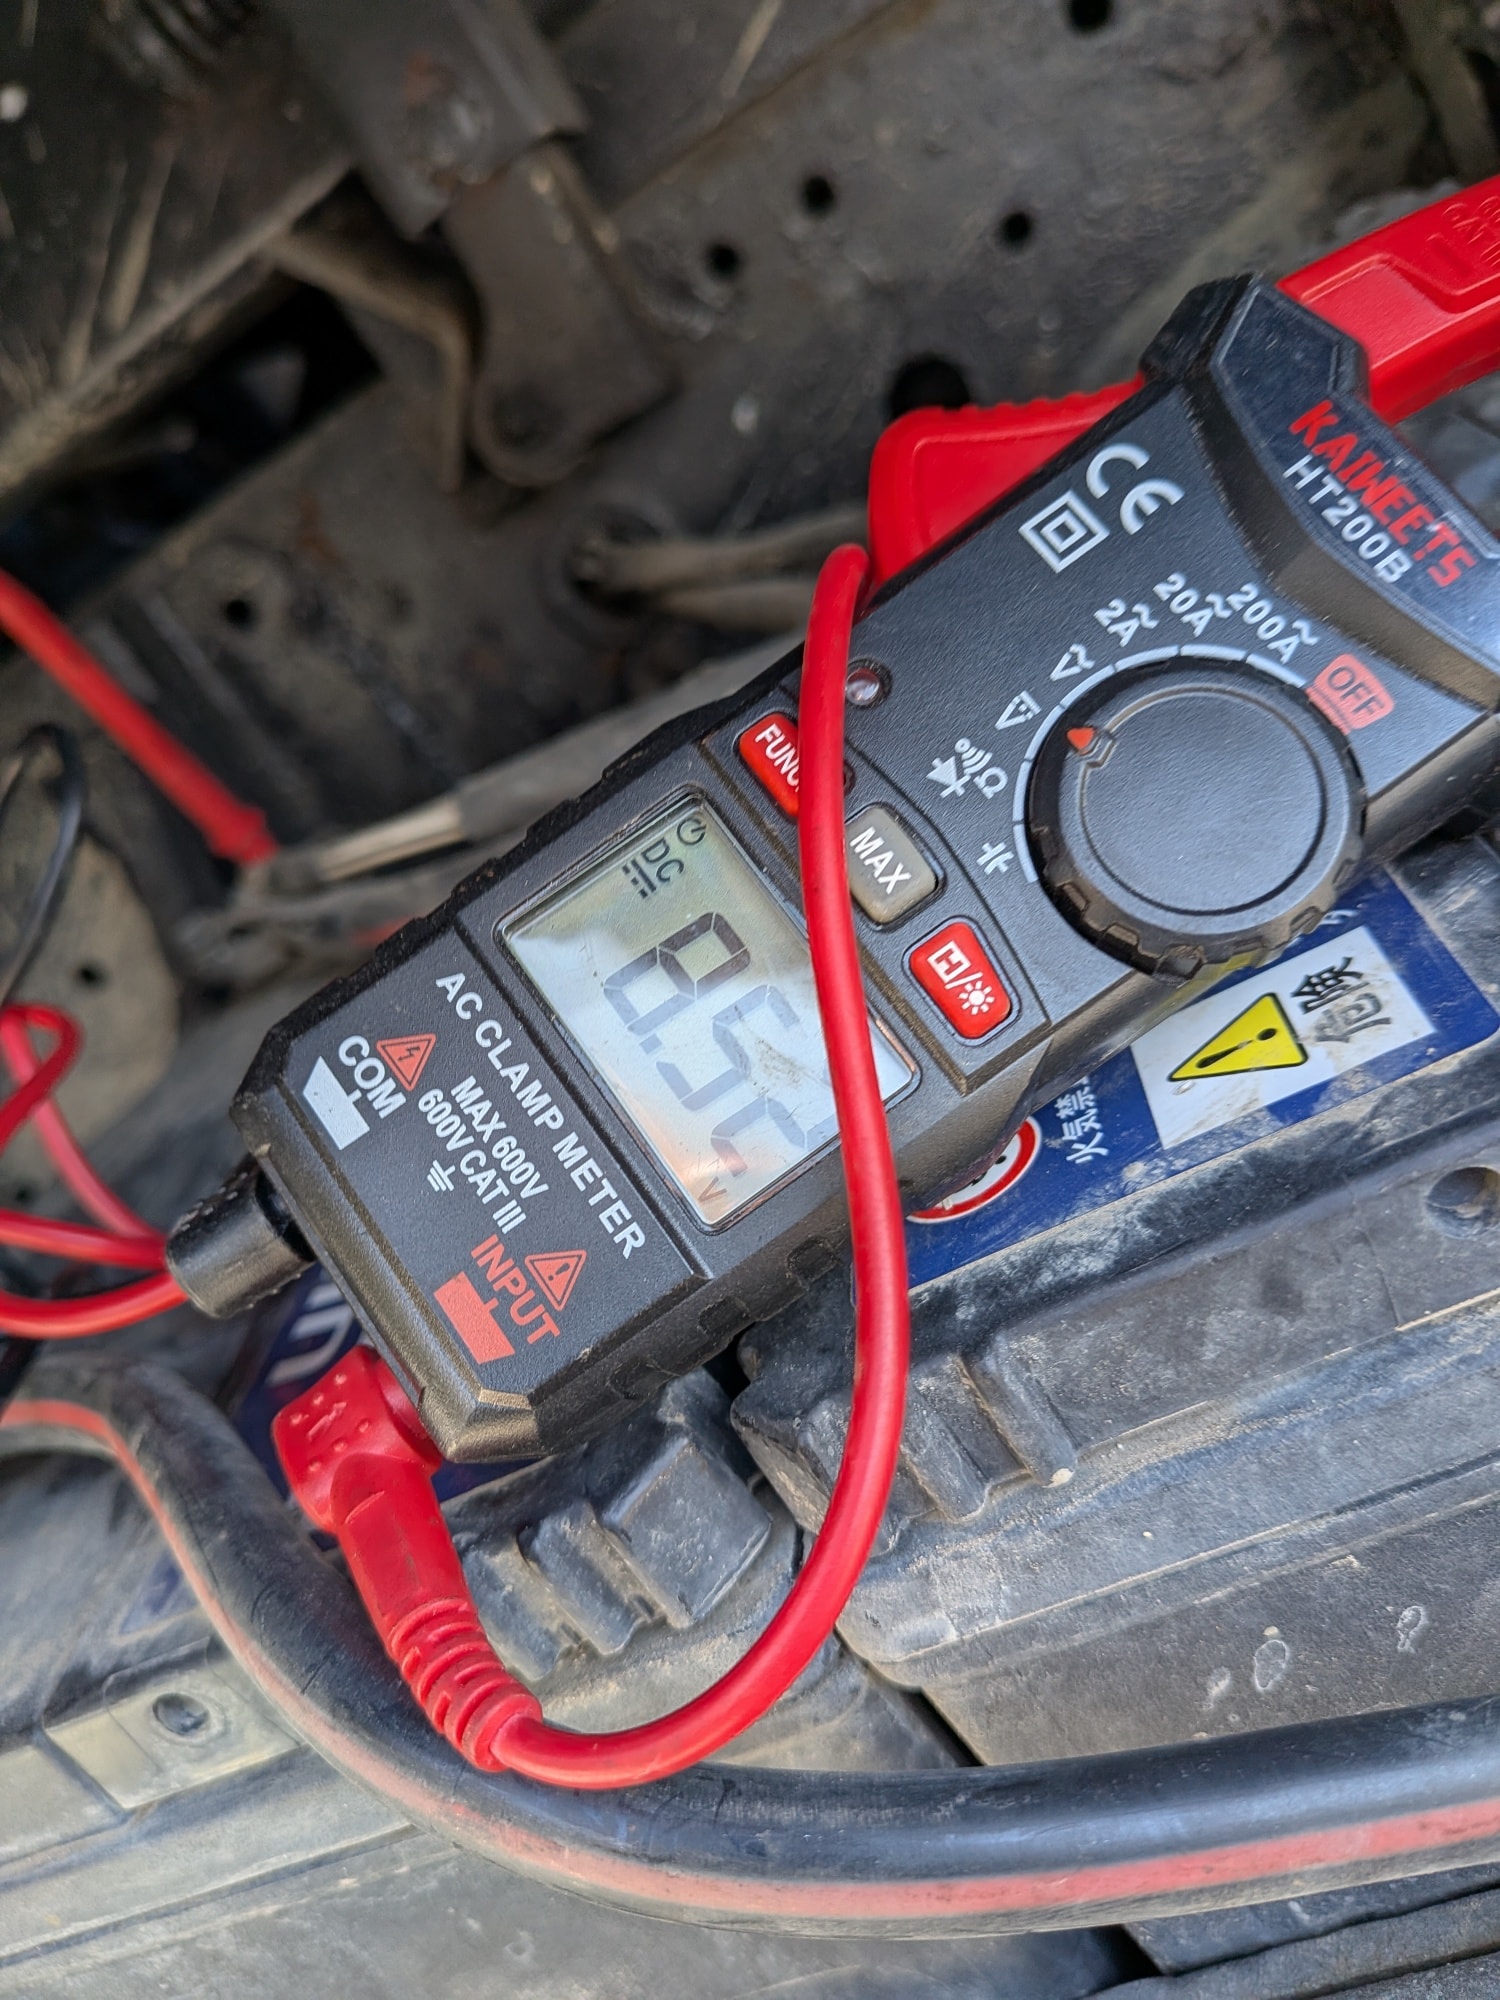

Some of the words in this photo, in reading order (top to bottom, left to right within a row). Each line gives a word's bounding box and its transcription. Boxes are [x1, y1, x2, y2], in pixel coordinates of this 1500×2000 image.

[1283, 454, 1413, 583] HT200B
[1289, 400, 1478, 587] KAIWEETS
[1327, 665, 1386, 719] OFF
[640, 839, 685, 883] DC
[850, 826, 911, 894] MAX
[1291, 956, 1392, 1043] 危険
[338, 1035, 406, 1119] COM
[435, 972, 483, 1019] AC
[475, 1019, 564, 1130] CLAMP
[552, 1132, 646, 1259] METER
[1054, 1076, 1109, 1164] 火気禁
[418, 1088, 474, 1151] 600V
[459, 1149, 510, 1204] CAT
[493, 1200, 526, 1234] III
[450, 1076, 505, 1139] MAX
[491, 1135, 549, 1199] 600V
[471, 1234, 560, 1344] INPUT
